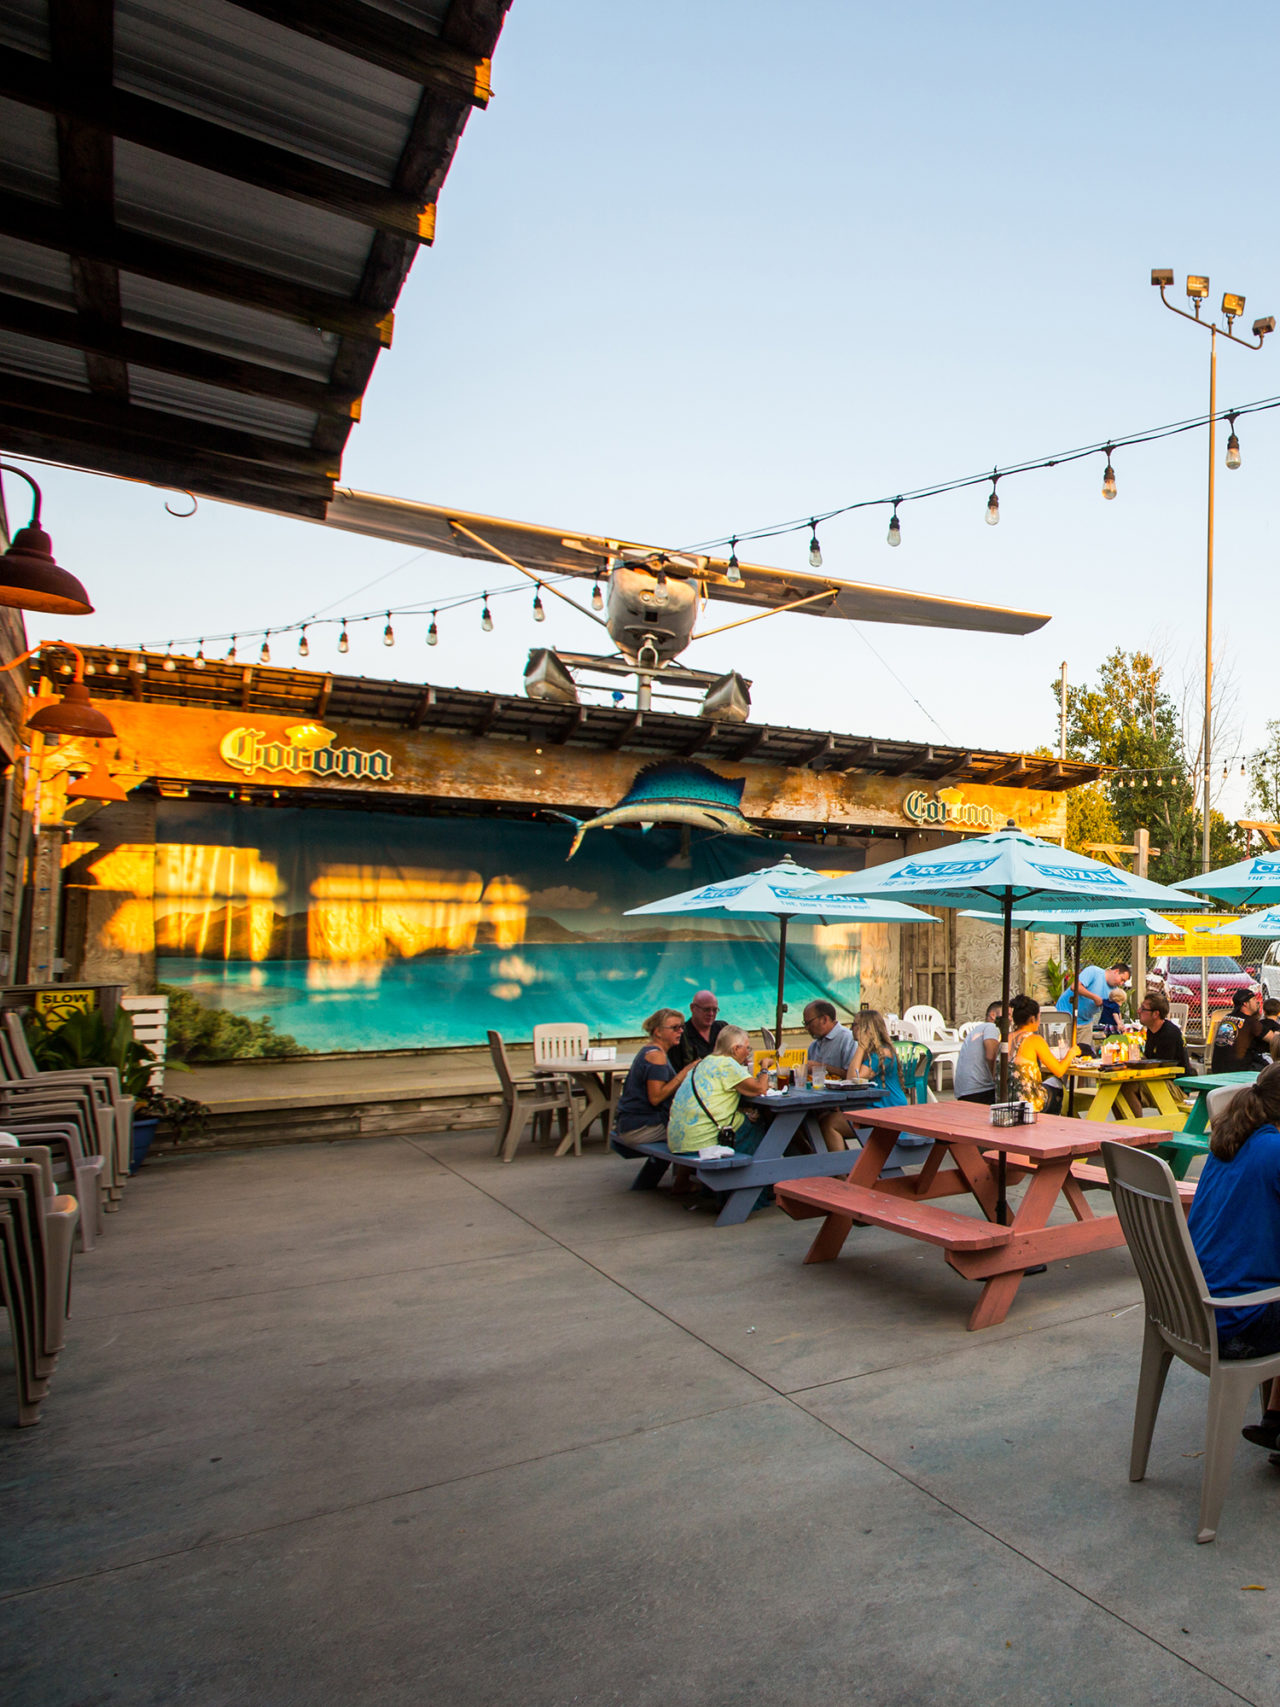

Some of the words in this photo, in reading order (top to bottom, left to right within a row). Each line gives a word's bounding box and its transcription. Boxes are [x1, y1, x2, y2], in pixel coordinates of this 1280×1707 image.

[220, 727, 394, 781] Corona
[903, 790, 994, 826] Corona
[900, 860, 991, 877] CRUZAN
[1034, 864, 1119, 882] CRUZAN
[42, 994, 88, 1004] SLOW
